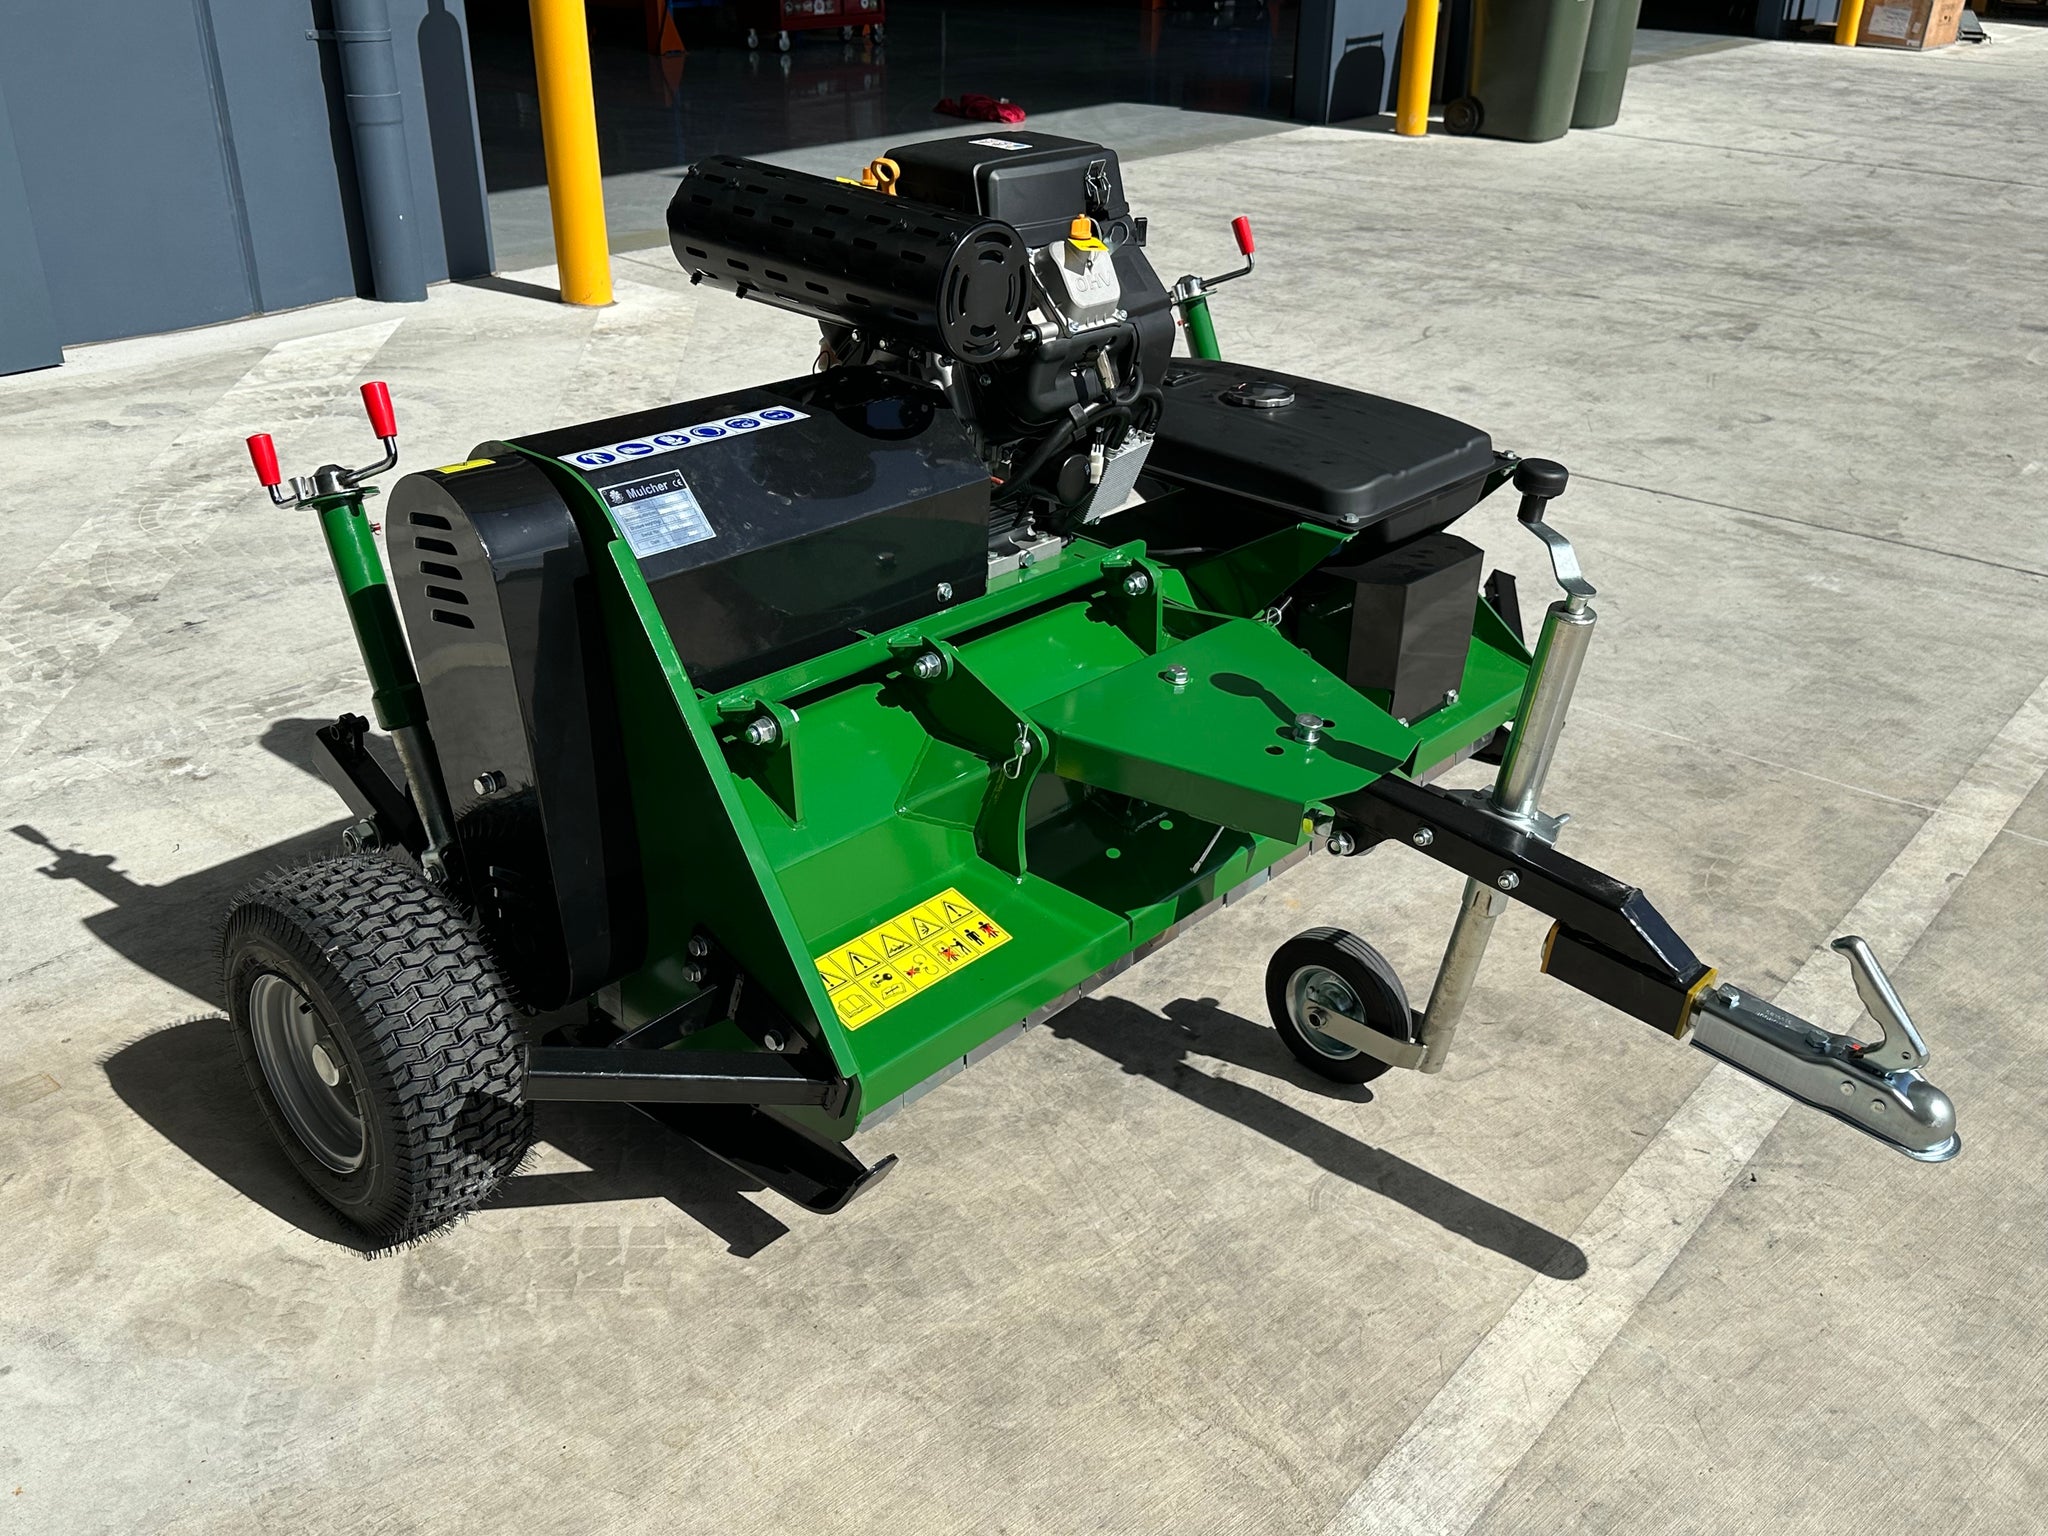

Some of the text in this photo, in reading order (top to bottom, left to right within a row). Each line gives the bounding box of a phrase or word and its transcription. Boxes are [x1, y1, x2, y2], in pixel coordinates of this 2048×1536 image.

[1076, 271, 1111, 292] OHV
[625, 478, 683, 499] Mulcher CE
